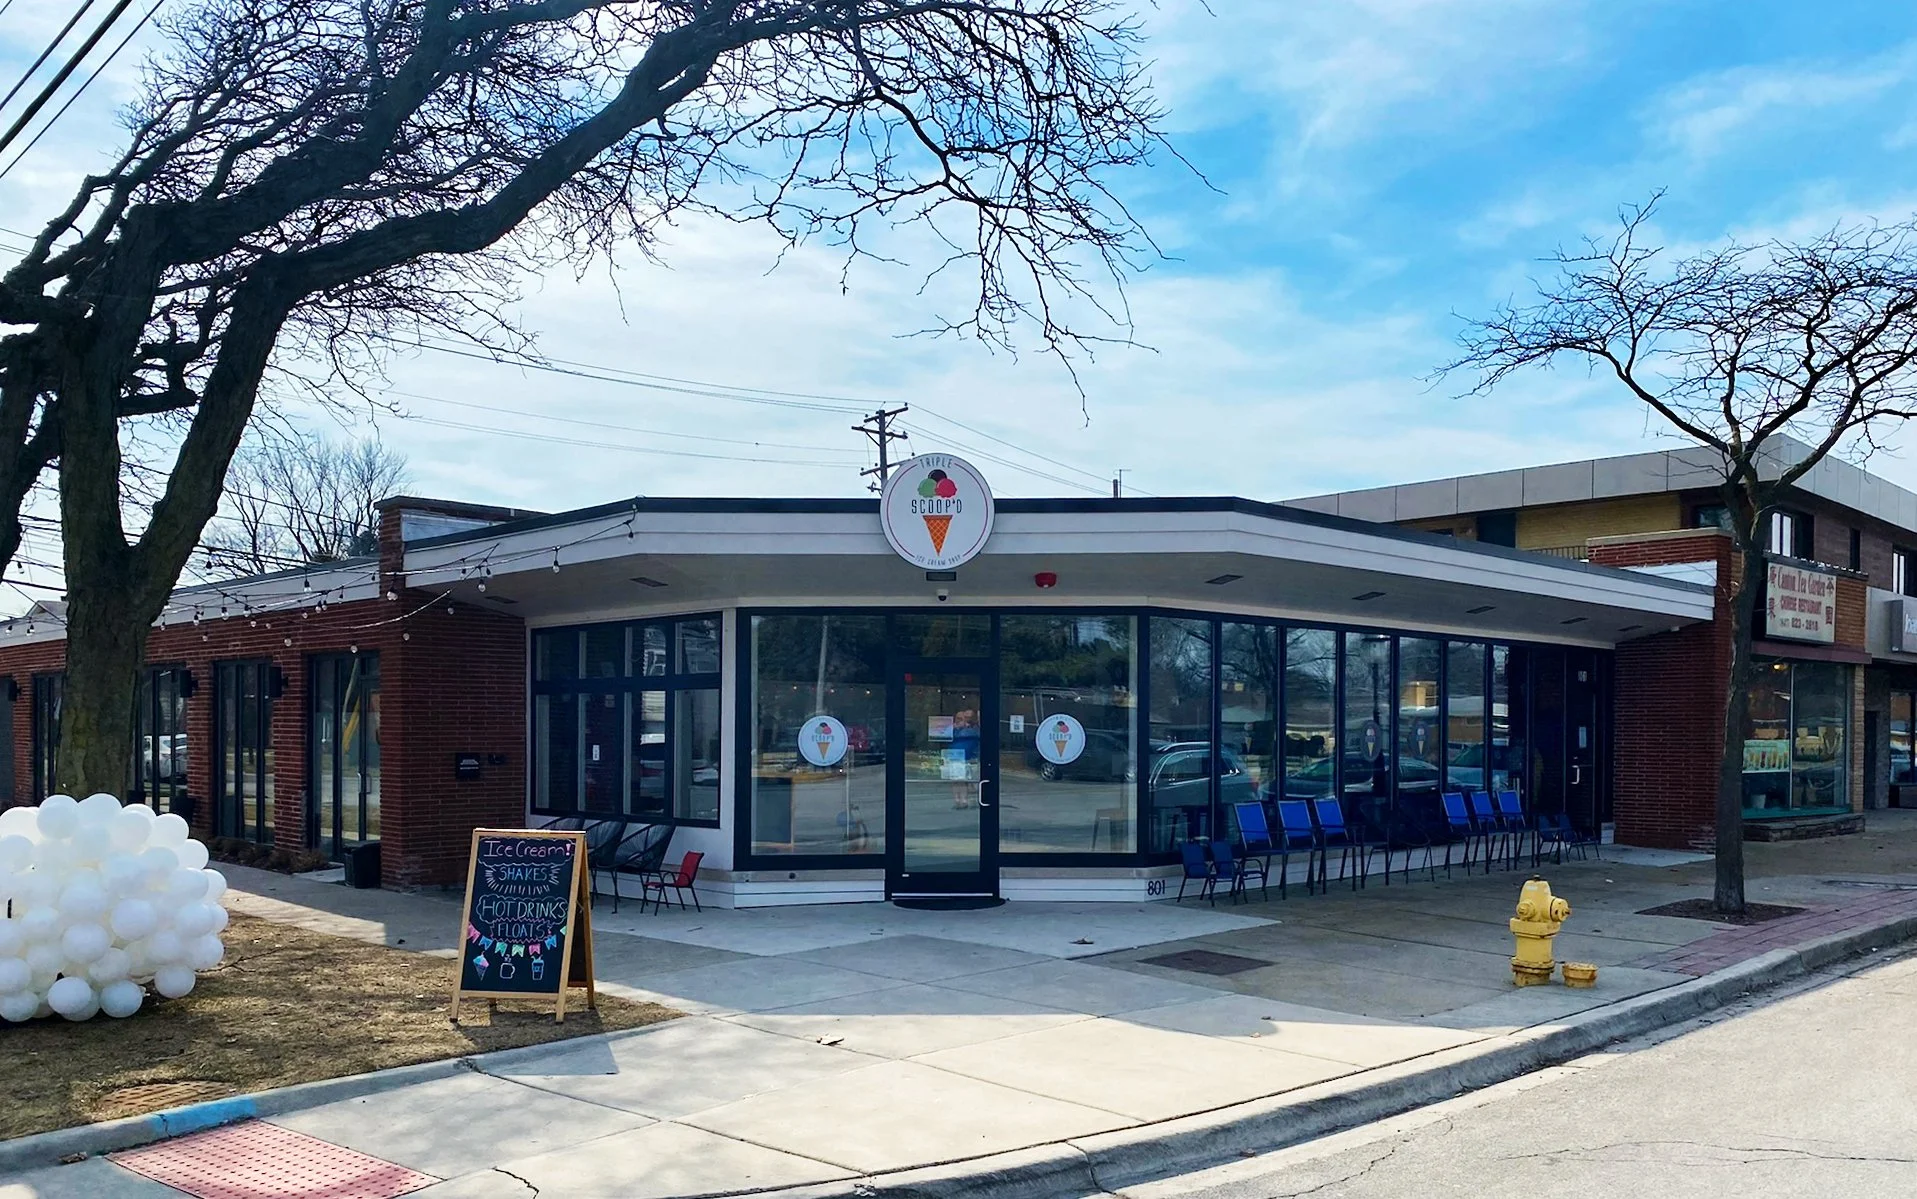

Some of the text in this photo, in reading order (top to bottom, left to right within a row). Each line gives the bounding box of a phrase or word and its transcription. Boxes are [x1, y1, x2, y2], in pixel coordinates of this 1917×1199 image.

[920, 456, 953, 469] TRIPLE
[911, 499, 963, 514] SCOOP'D
[1778, 566, 1796, 591] Canton
[1798, 571, 1807, 593] Tea
[483, 840, 571, 858] Ice Cream!
[498, 866, 548, 881] SHAKES
[1147, 880, 1165, 896] 801
[482, 900, 566, 919] HOT DRINKS
[498, 923, 545, 938] FLOATS
